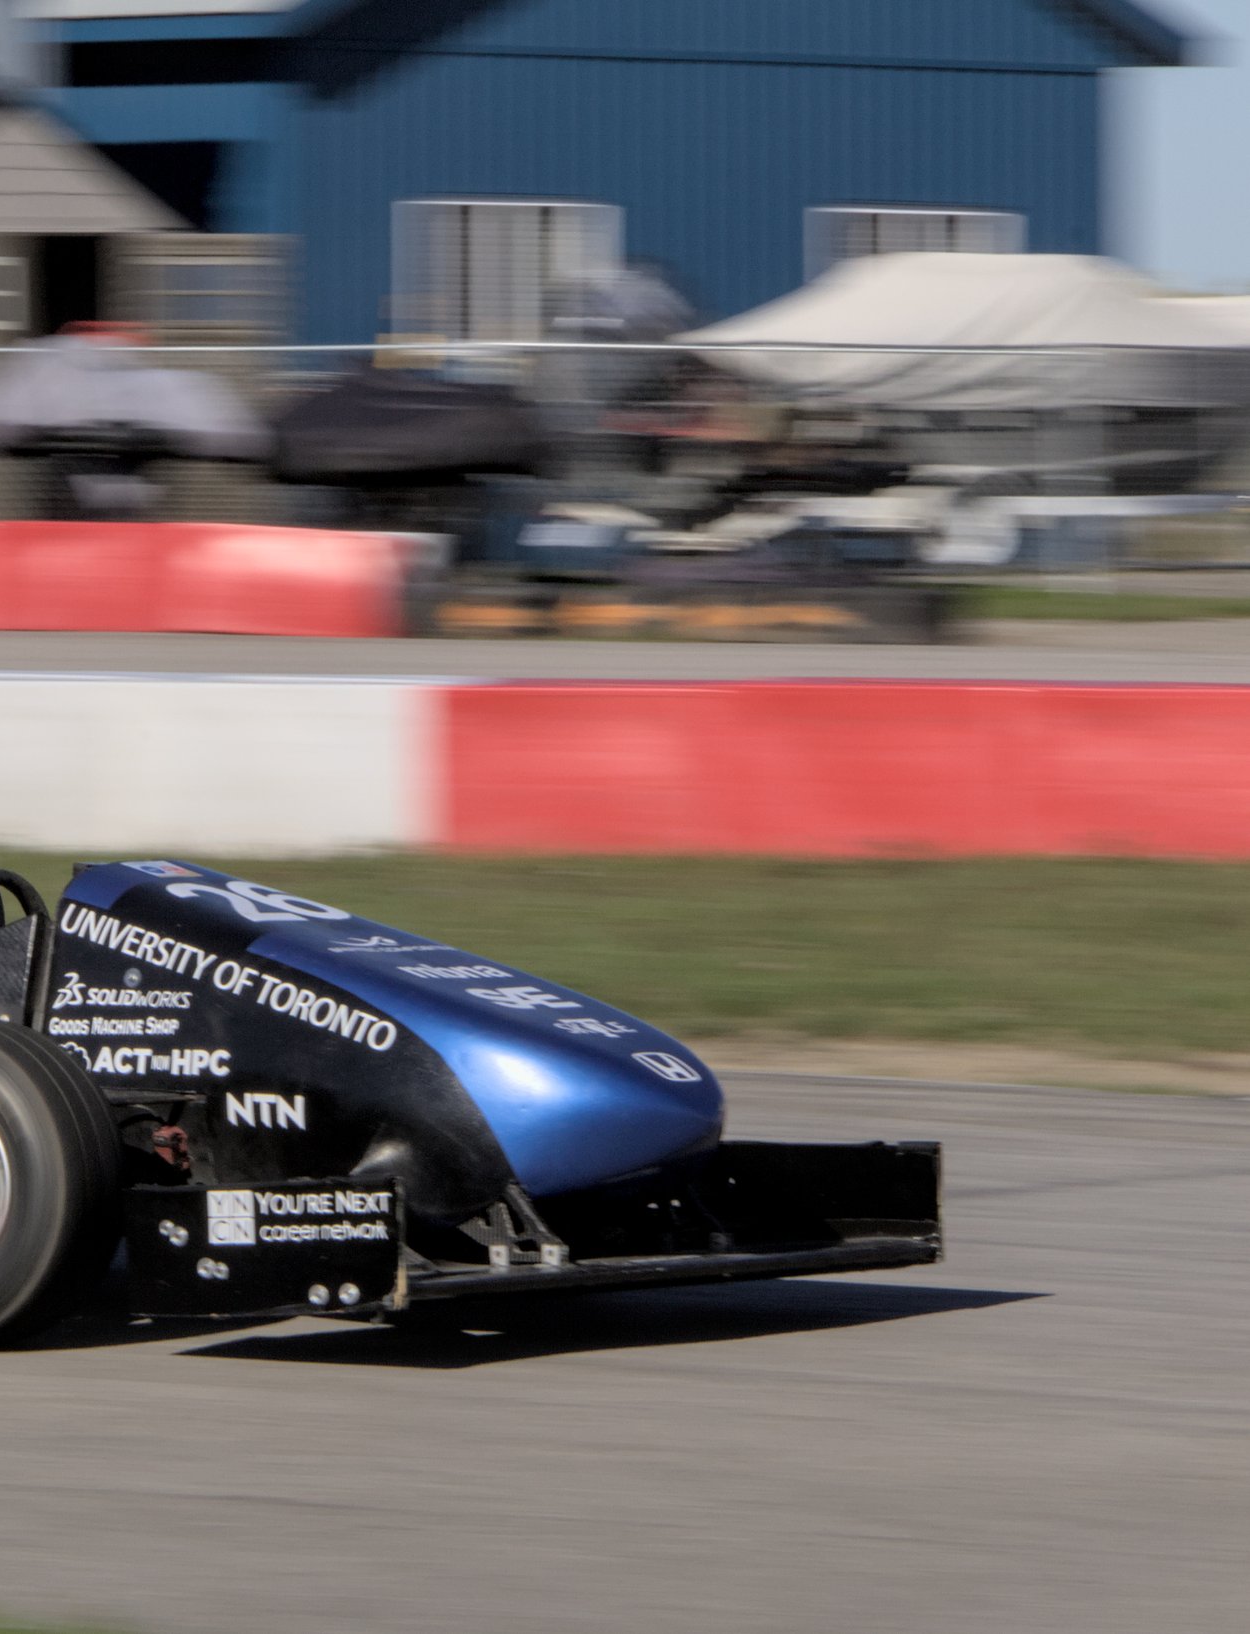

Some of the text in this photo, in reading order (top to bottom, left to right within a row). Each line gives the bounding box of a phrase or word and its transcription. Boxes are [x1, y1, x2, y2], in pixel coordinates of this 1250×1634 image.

[165, 880, 351, 923] 26
[60, 903, 397, 1052] UNIVERSITY OF TORONTO
[396, 963, 515, 980] mbna
[85, 987, 194, 1010] SOLIDWORKS
[48, 1015, 181, 1036] GOODS MACHINE SHOP
[92, 1046, 153, 1075] ACT
[170, 1048, 232, 1077] HPC
[224, 1091, 307, 1132] NTN
[254, 1189, 393, 1216] YOU'RE NEXT
[258, 1224, 320, 1243] career
